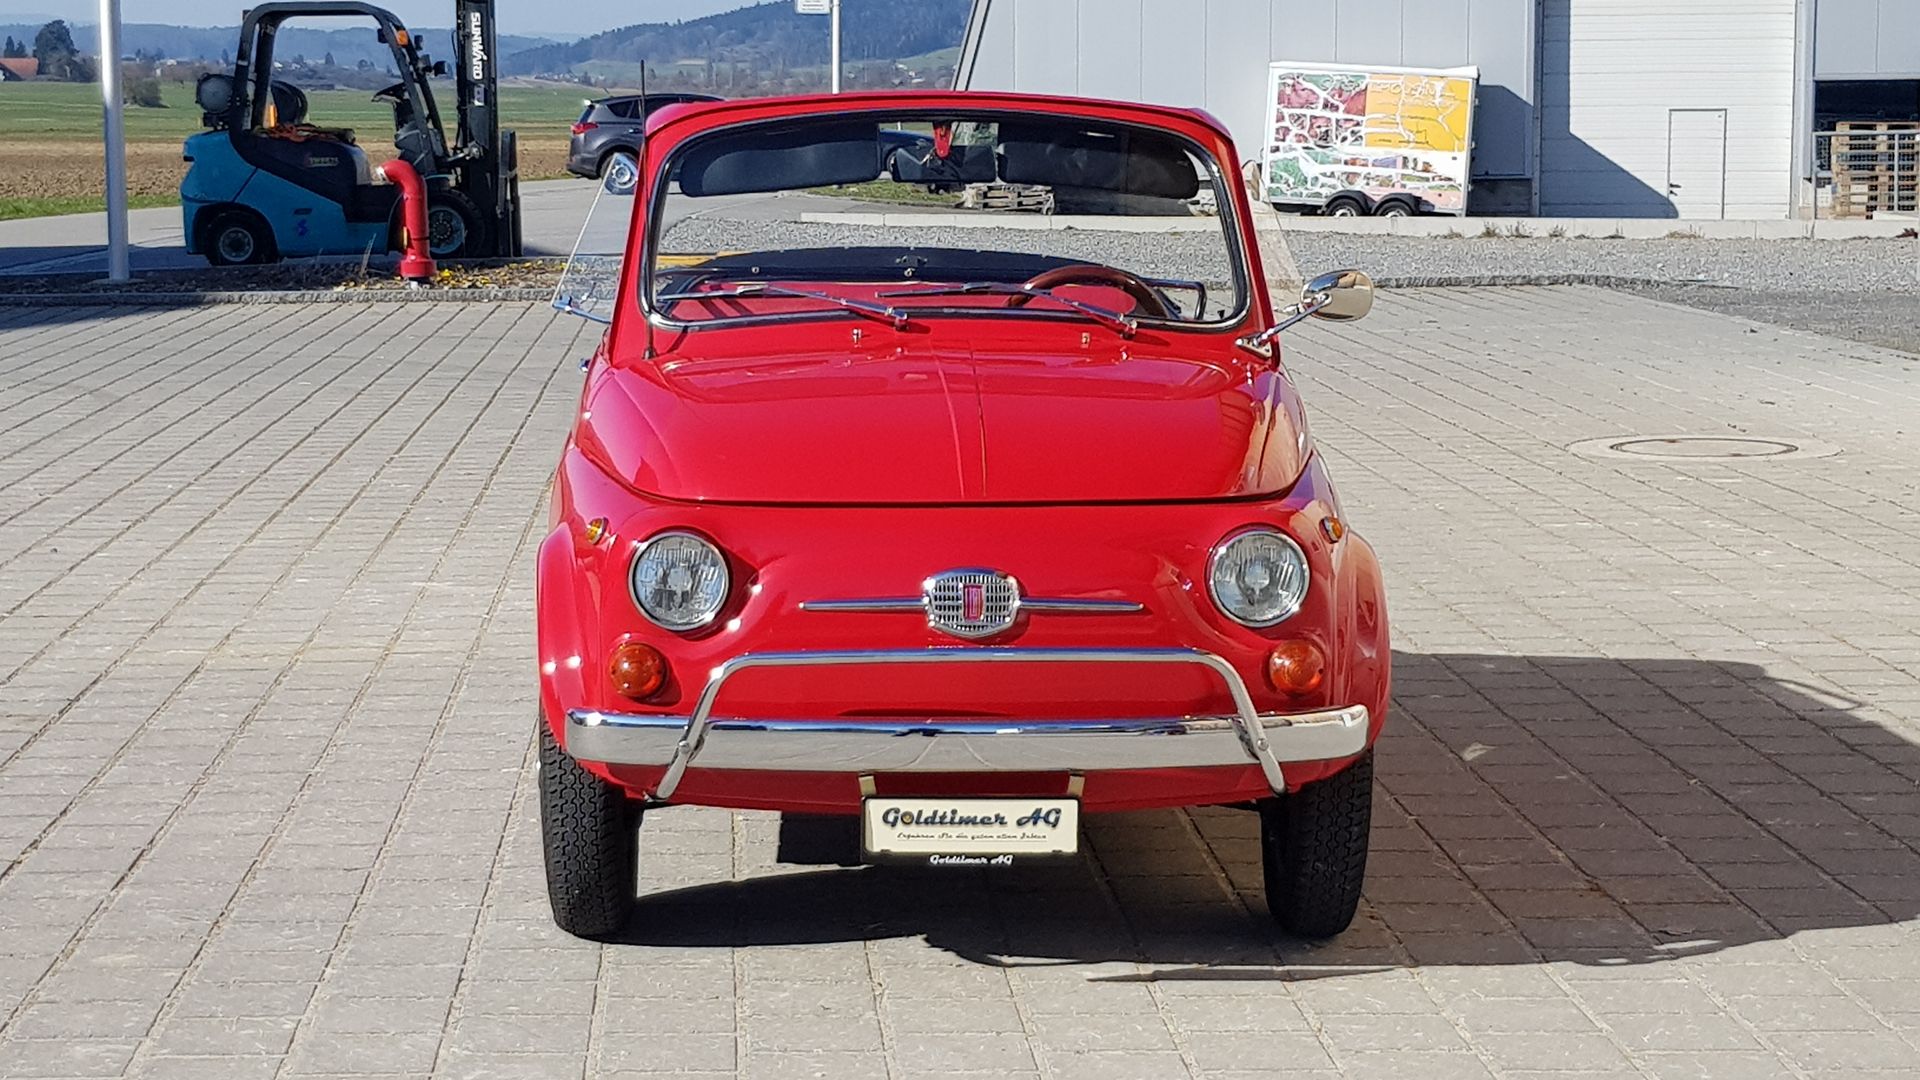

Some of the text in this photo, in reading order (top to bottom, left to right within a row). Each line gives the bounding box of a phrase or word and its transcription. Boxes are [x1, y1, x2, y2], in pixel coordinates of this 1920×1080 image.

[470, 11, 488, 80] SUNWARD
[882, 807, 1062, 828] Goldtimer AG
[929, 854, 1014, 866] Goldtimer AG
